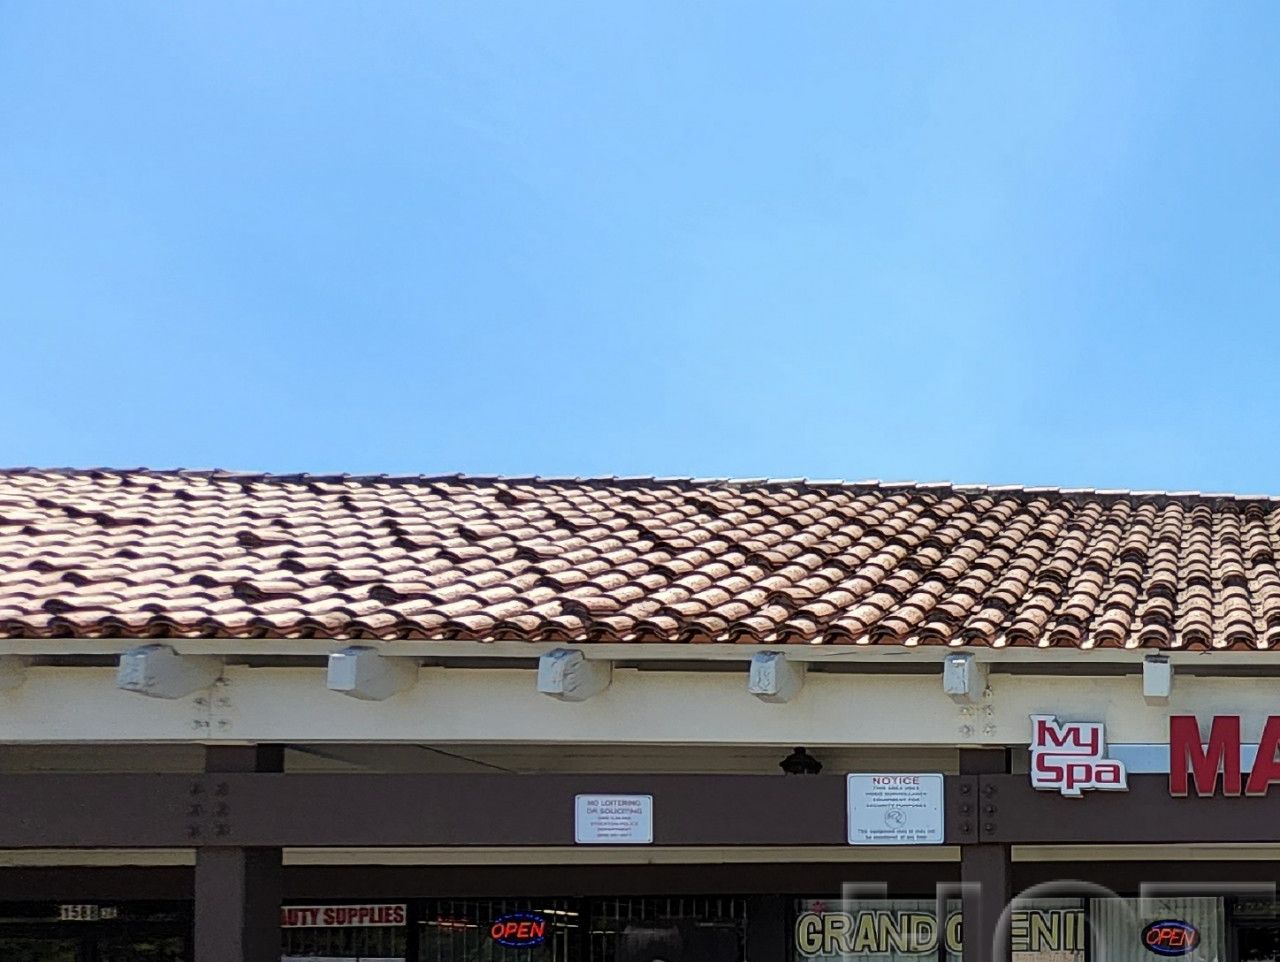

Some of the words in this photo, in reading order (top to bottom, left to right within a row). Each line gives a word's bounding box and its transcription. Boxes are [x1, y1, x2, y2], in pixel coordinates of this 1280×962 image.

[1037, 723, 1100, 756] Ivy
[872, 776, 920, 785] NOTICE
[1036, 757, 1122, 791] Spa
[323, 905, 404, 925] SUPPLIES
[491, 921, 546, 940] OPEN
[797, 910, 939, 956] GRAND
[1145, 925, 1195, 947] OPEN
